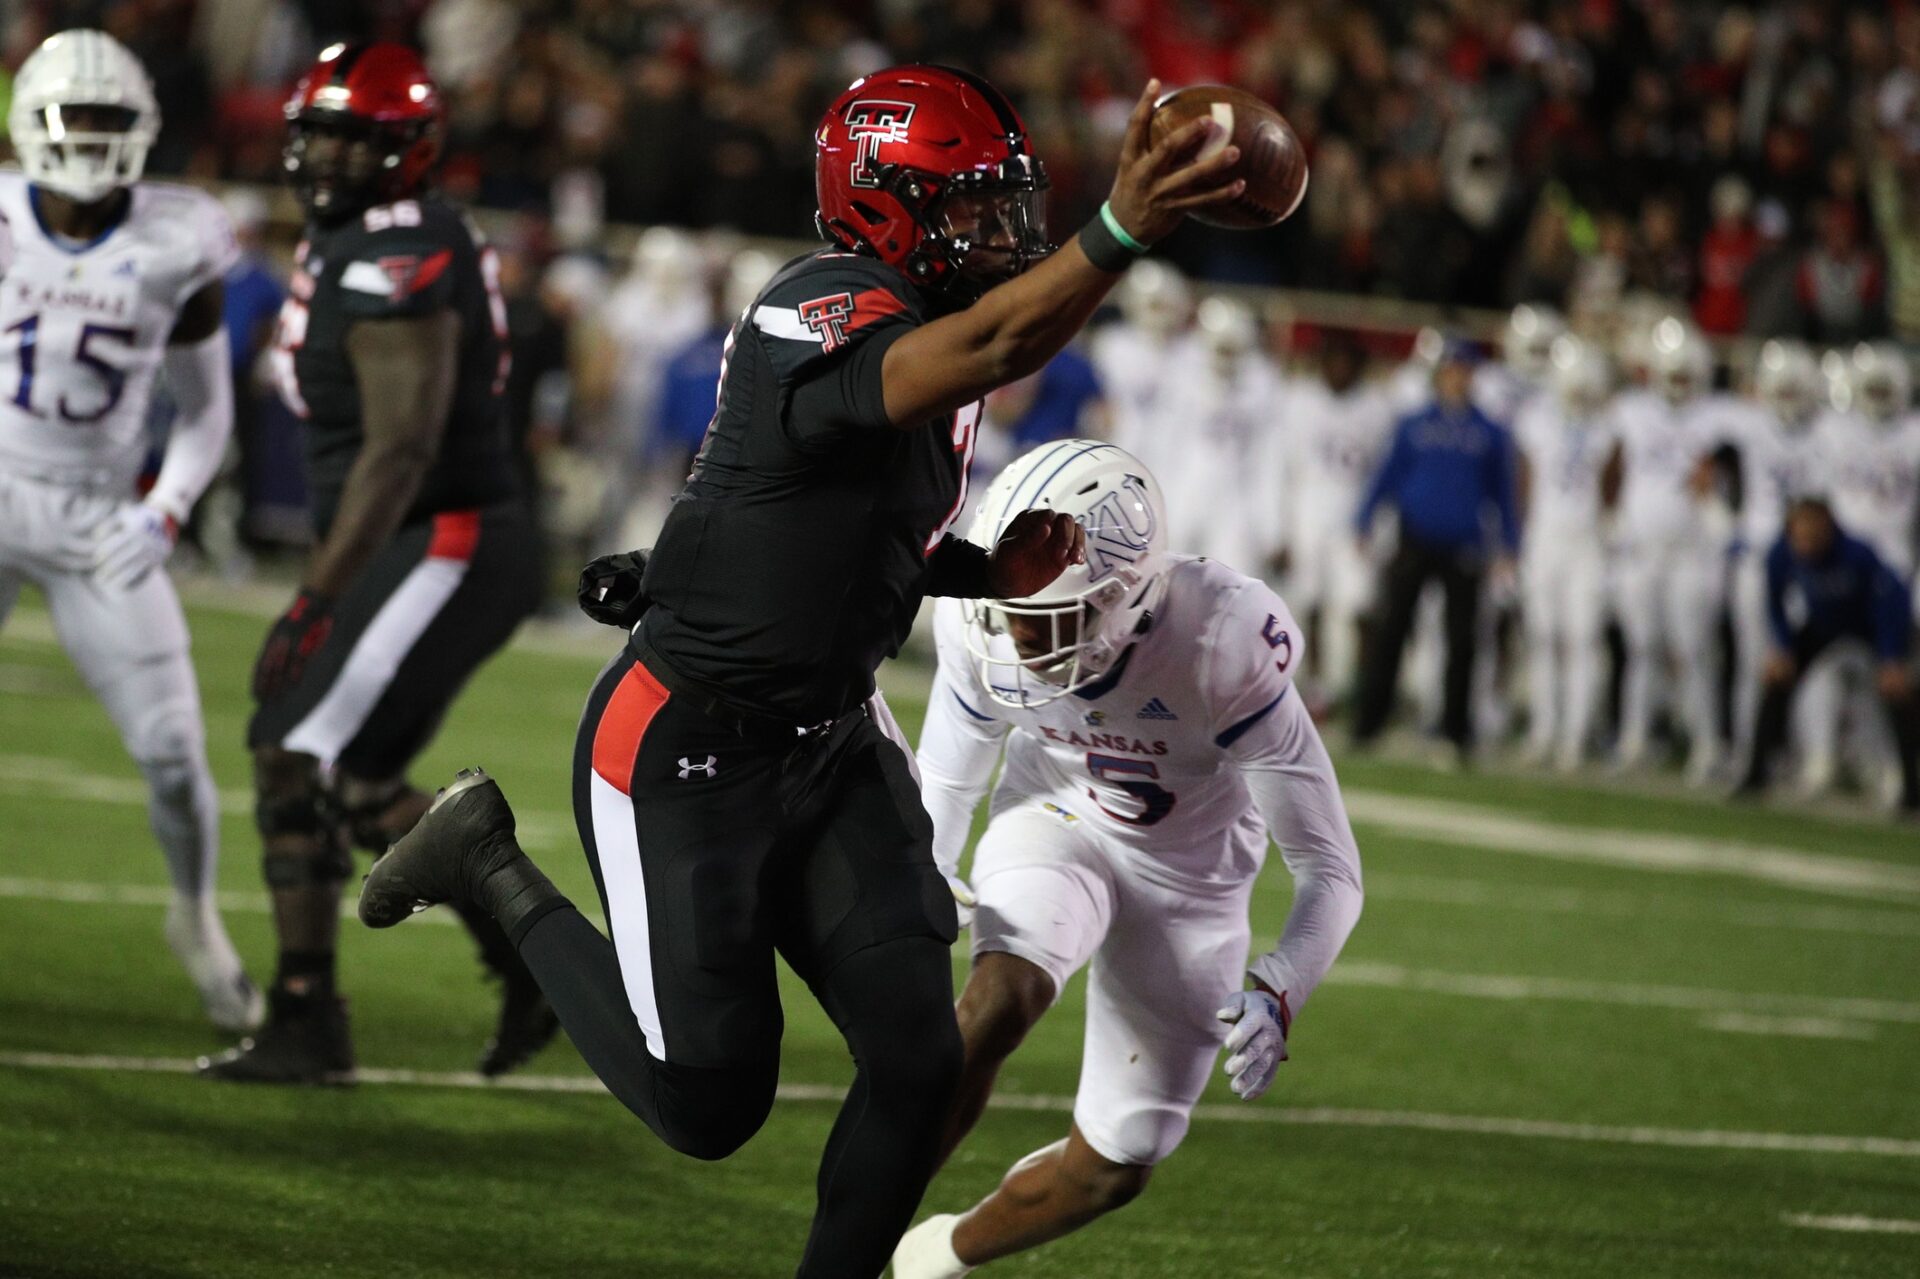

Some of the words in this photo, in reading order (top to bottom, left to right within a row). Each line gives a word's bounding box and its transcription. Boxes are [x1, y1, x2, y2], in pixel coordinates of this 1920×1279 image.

[4, 311, 138, 424] 15
[1260, 613, 1292, 674] 5
[1039, 725, 1168, 756] KANSAS
[1086, 752, 1177, 827] 5
